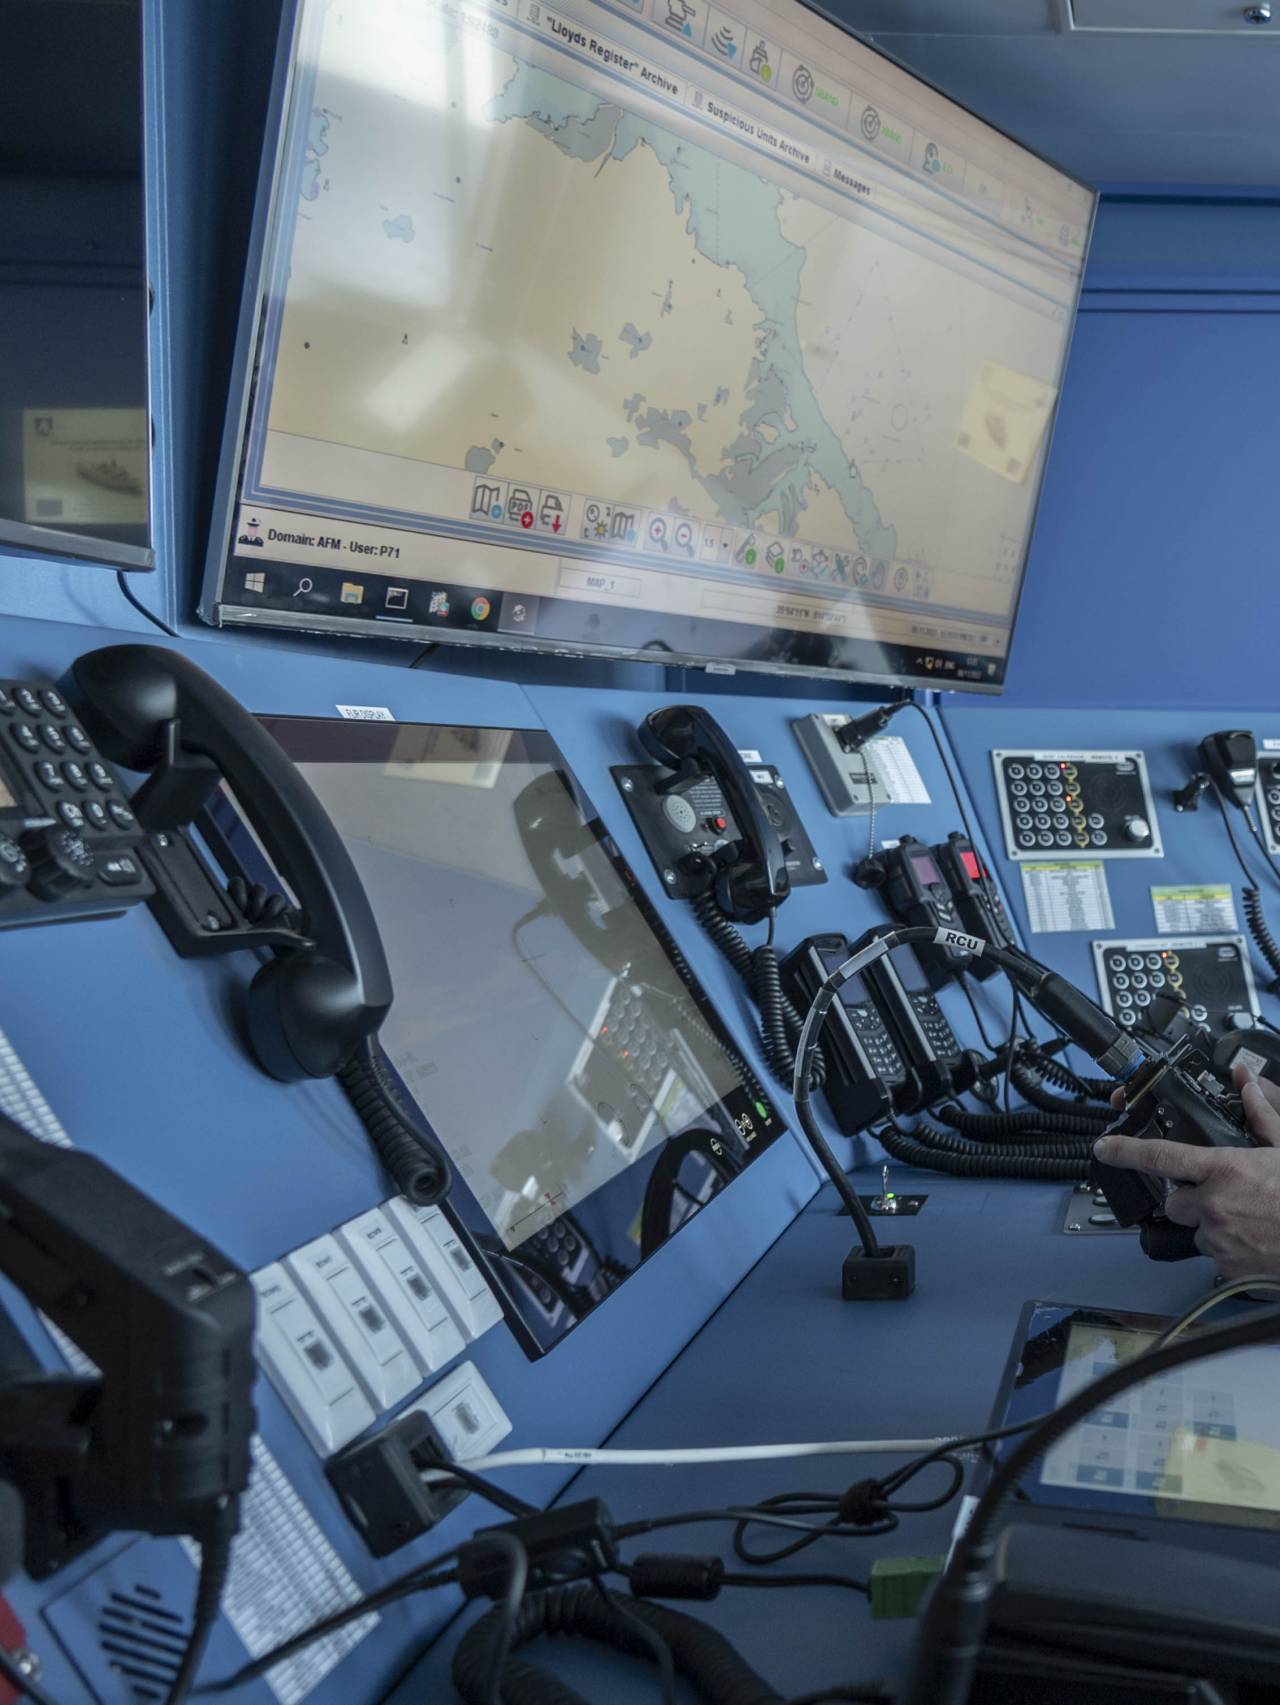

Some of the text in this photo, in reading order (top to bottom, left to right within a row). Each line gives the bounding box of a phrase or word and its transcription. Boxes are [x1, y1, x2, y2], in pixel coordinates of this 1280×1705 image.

[547, 16, 679, 95] "Lloyds Register" Archive
[707, 102, 810, 164] Suspicious Units Archive
[833, 168, 871, 196] Messages
[268, 528, 315, 546] Domain:
[317, 536, 341, 550] AFM
[349, 541, 378, 556] User:
[379, 545, 401, 558] P71
[945, 932, 978, 950] RCU
